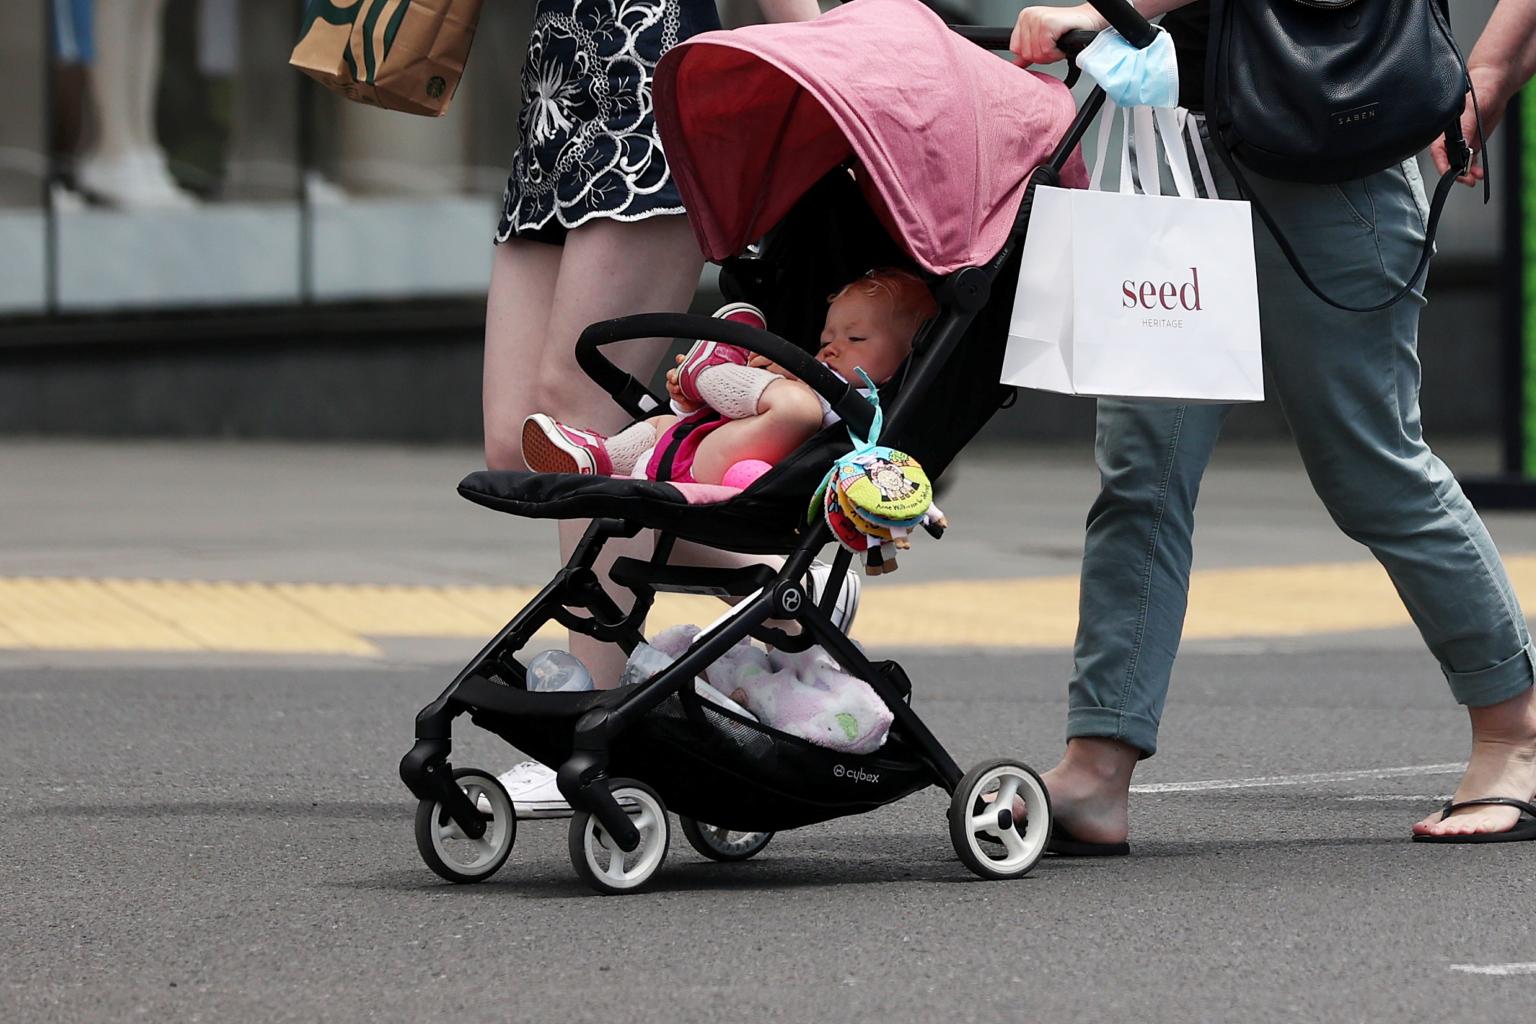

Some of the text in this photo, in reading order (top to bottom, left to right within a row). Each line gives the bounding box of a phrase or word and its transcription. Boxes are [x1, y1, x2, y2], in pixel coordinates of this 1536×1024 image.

[1121, 267, 1203, 311] seed
[1142, 318, 1184, 329] HERITAGE
[846, 768, 880, 784] cybex
